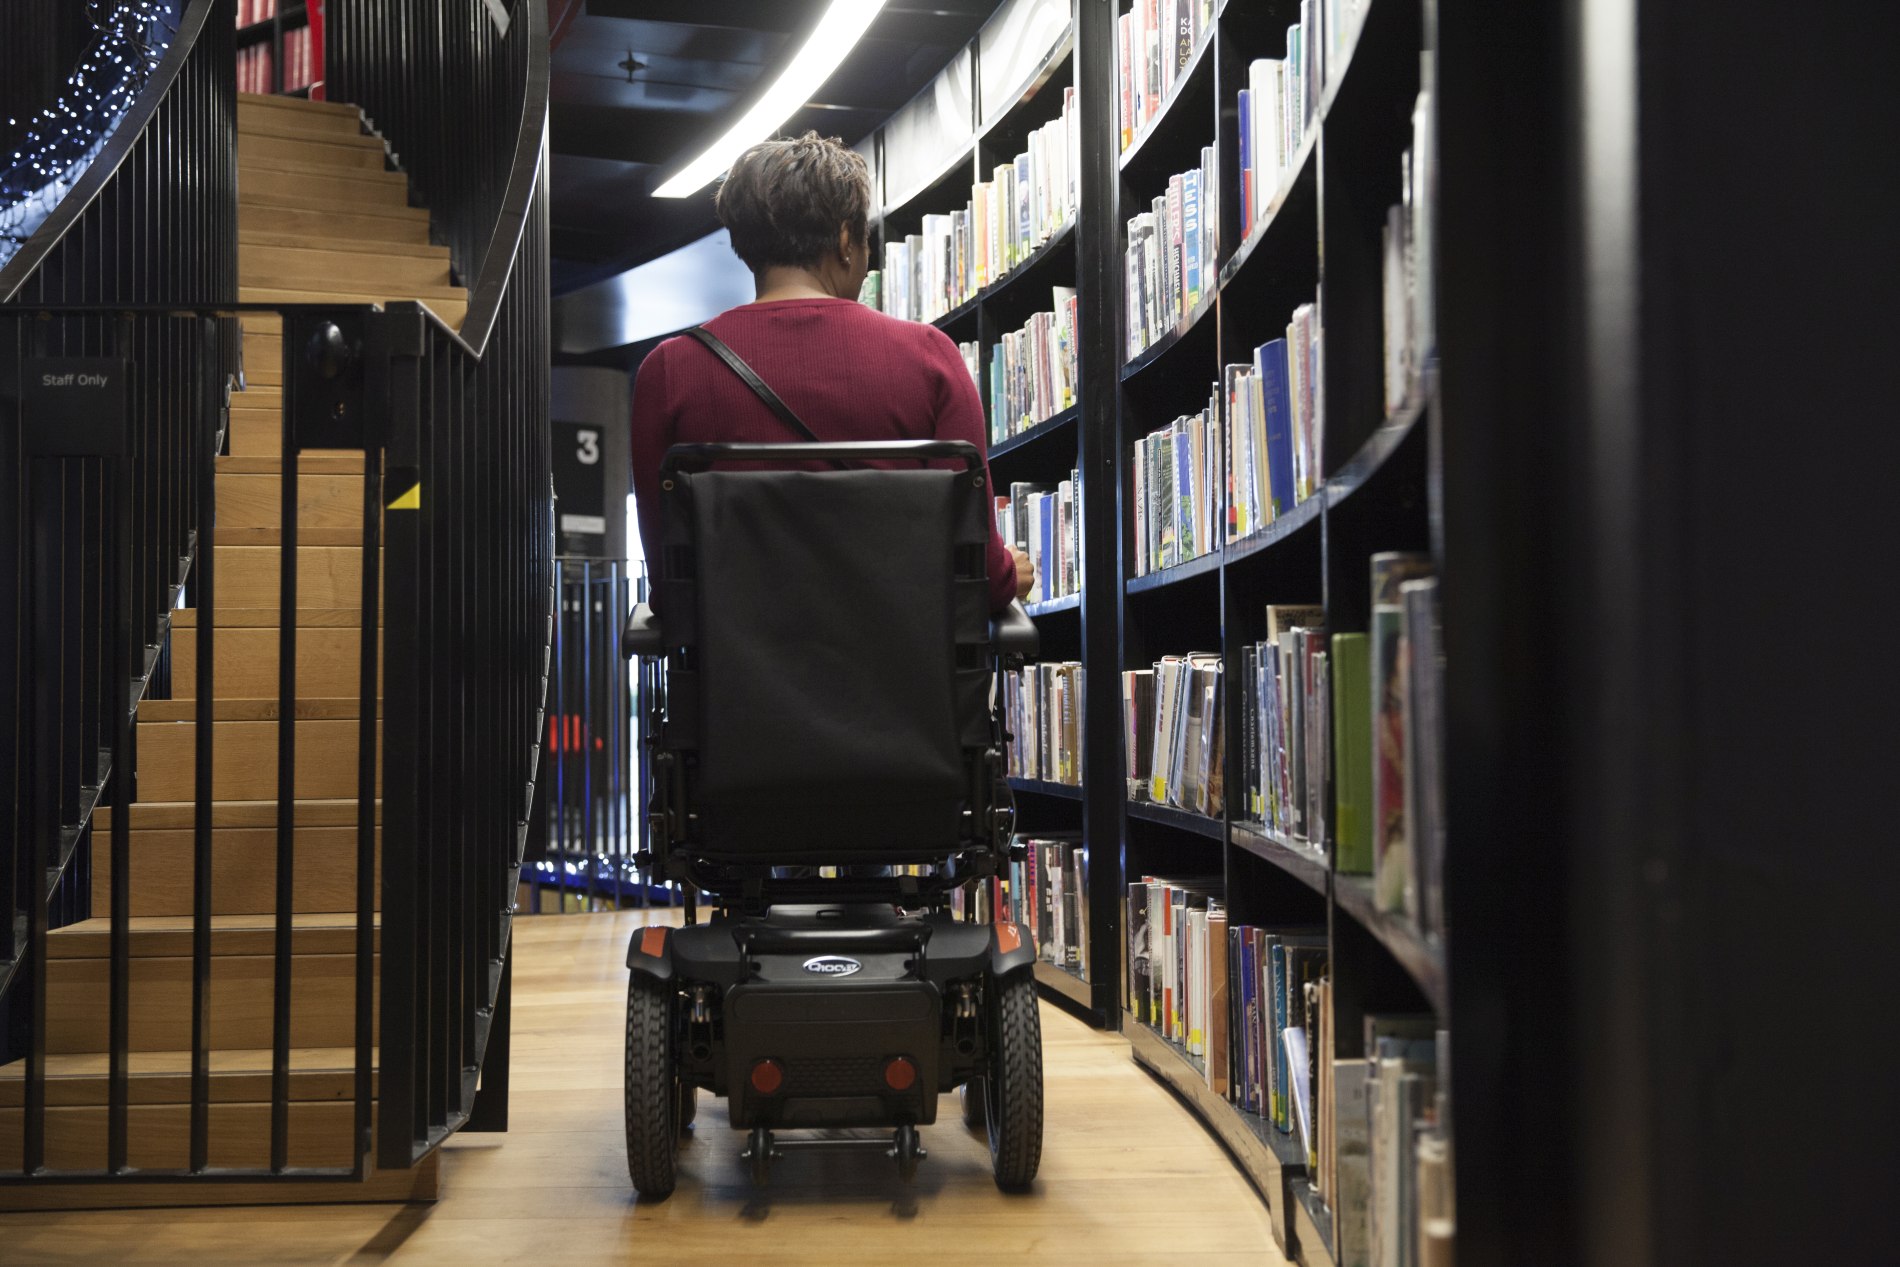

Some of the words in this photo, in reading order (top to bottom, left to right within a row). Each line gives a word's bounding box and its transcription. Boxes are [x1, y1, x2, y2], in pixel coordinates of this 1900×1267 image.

[42, 374, 74, 386] Staff
[77, 374, 108, 388] Only
[576, 429, 599, 465] 3
